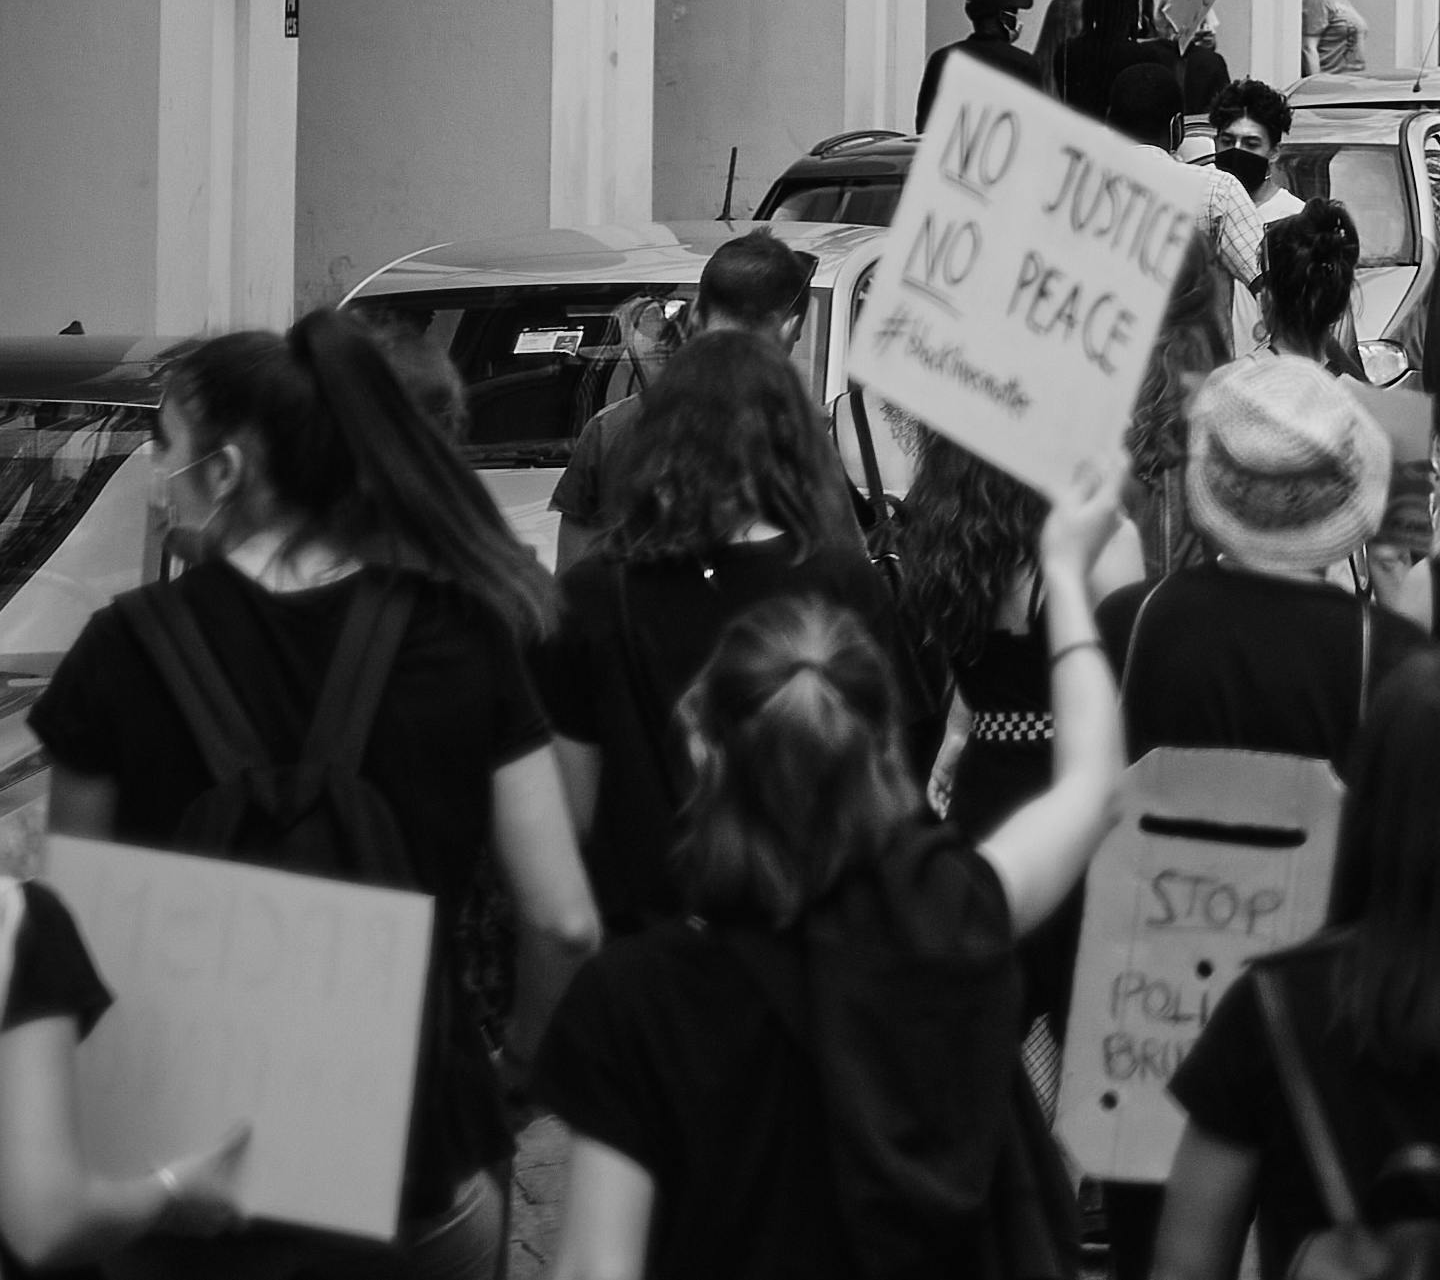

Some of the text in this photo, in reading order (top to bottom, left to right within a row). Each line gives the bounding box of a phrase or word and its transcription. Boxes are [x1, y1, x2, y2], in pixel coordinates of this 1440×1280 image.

[940, 102, 1199, 287] NO JUSTICE
[902, 210, 1138, 377] NO PEACE
[1145, 869, 1285, 937] STOP
[1110, 970, 1210, 1027] POLI
